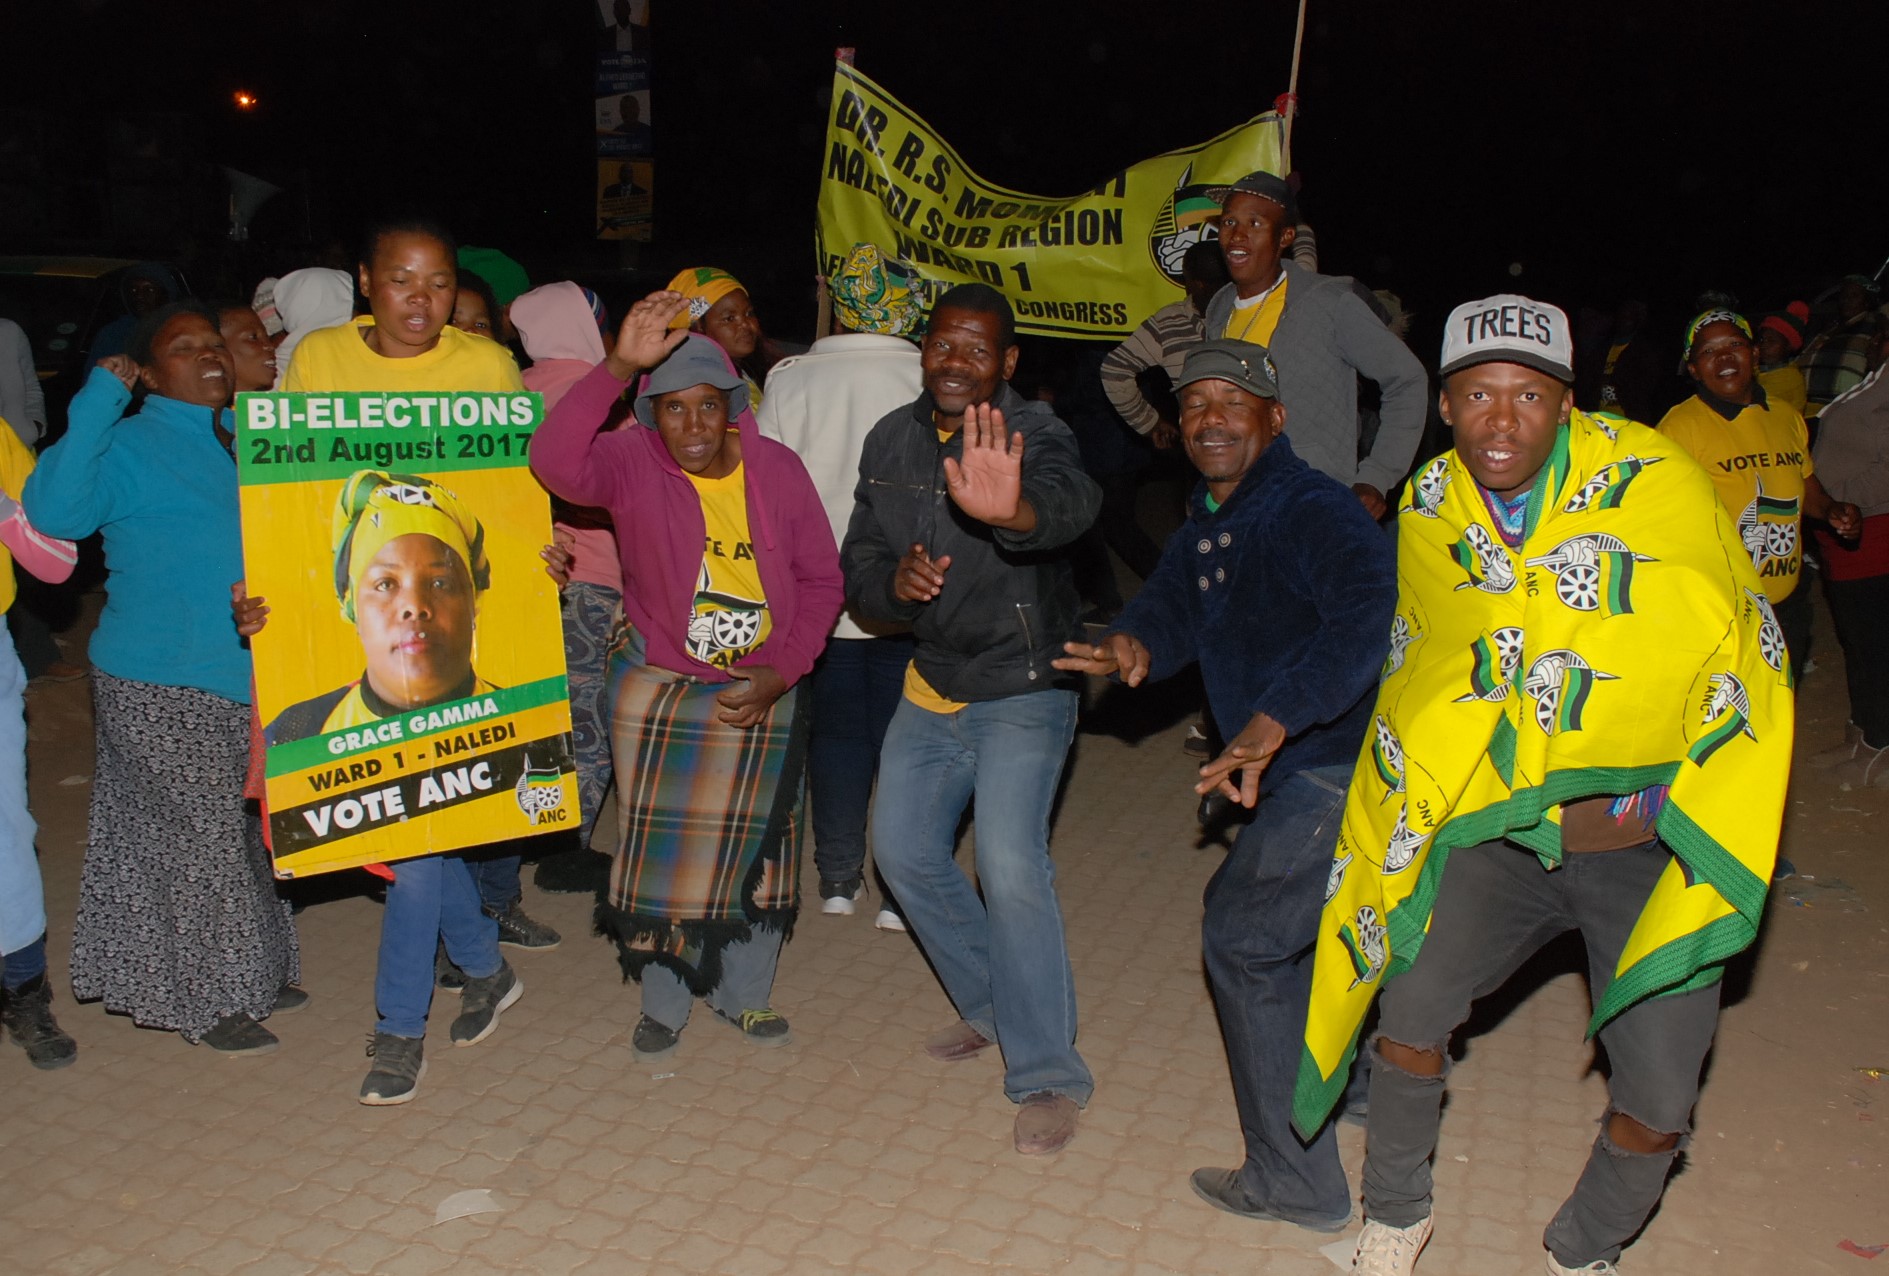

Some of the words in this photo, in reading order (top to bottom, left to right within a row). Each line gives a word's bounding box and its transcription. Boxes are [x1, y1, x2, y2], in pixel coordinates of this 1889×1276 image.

[836, 89, 888, 159] DR.
[892, 130, 951, 204] R.S.
[920, 207, 991, 249] SUB
[997, 208, 1124, 249] REGION
[897, 230, 1004, 287] WARD
[1010, 262, 1032, 291] 1
[1014, 299, 1128, 326] CONGRESS
[1464, 305, 1551, 346] TREES
[247, 396, 534, 429] BI-ELECTIONS
[251, 437, 316, 464] 2nd
[328, 435, 446, 467] August
[456, 432, 532, 458] 2017
[1717, 452, 1770, 472] VOTE
[1775, 452, 1804, 466] ANC
[1760, 557, 1798, 577] ANC
[1525, 571, 1539, 597] ANC
[1409, 606, 1422, 631] ANC
[1744, 596, 1753, 624] ANC
[1700, 685, 1717, 712] ANC
[328, 721, 403, 755] GRACE
[409, 698, 499, 733] GAMMA
[307, 758, 382, 792] WARD
[393, 751, 404, 769] 1
[434, 721, 516, 759] NALEDI
[303, 785, 406, 838] VOTE
[418, 762, 493, 808] ANC
[1417, 799, 1436, 828] ANC
[537, 809, 567, 826] ANC
